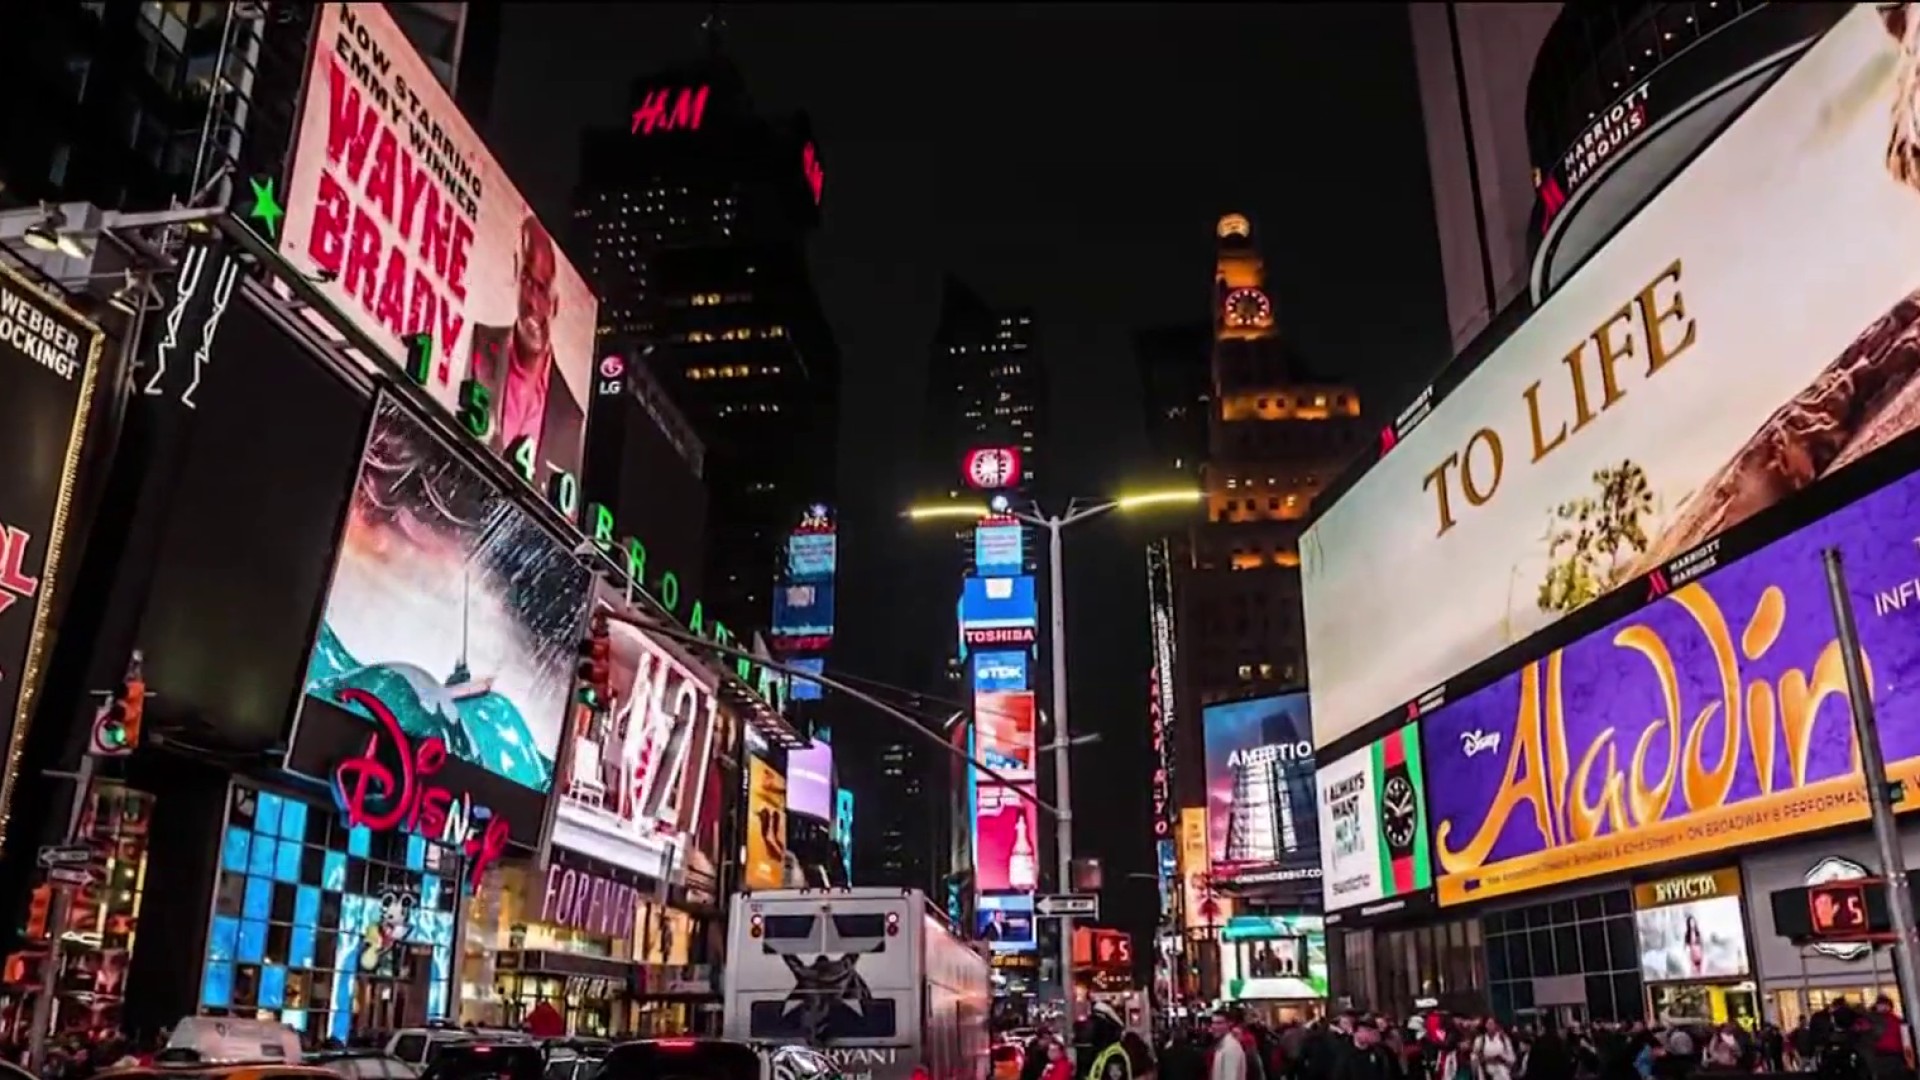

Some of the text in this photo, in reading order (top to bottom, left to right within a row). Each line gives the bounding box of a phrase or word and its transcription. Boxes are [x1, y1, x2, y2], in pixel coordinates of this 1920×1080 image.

[336, 33, 478, 224] EMMY WINNER
[340, 4, 482, 199] NOW STARRING
[631, 86, 709, 135] H&M
[1565, 82, 1650, 171] MARRIOTT
[328, 57, 475, 303] WAYNE
[1567, 112, 1642, 190] MARQUIS
[308, 168, 464, 387] BRADY!
[1, 287, 80, 356] WEBBER
[600, 381, 622, 394] LG
[1423, 258, 1696, 538] TO LIFE
[965, 629, 1035, 643] TOSHIBA
[1437, 580, 1873, 873] Aladdin
[1687, 824, 1705, 842] ON
[1706, 810, 1769, 838] BROADWAY
[1847, 897, 1863, 925] 5
[1119, 939, 1130, 961] 5
[825, 1047, 896, 1065] RYANT
